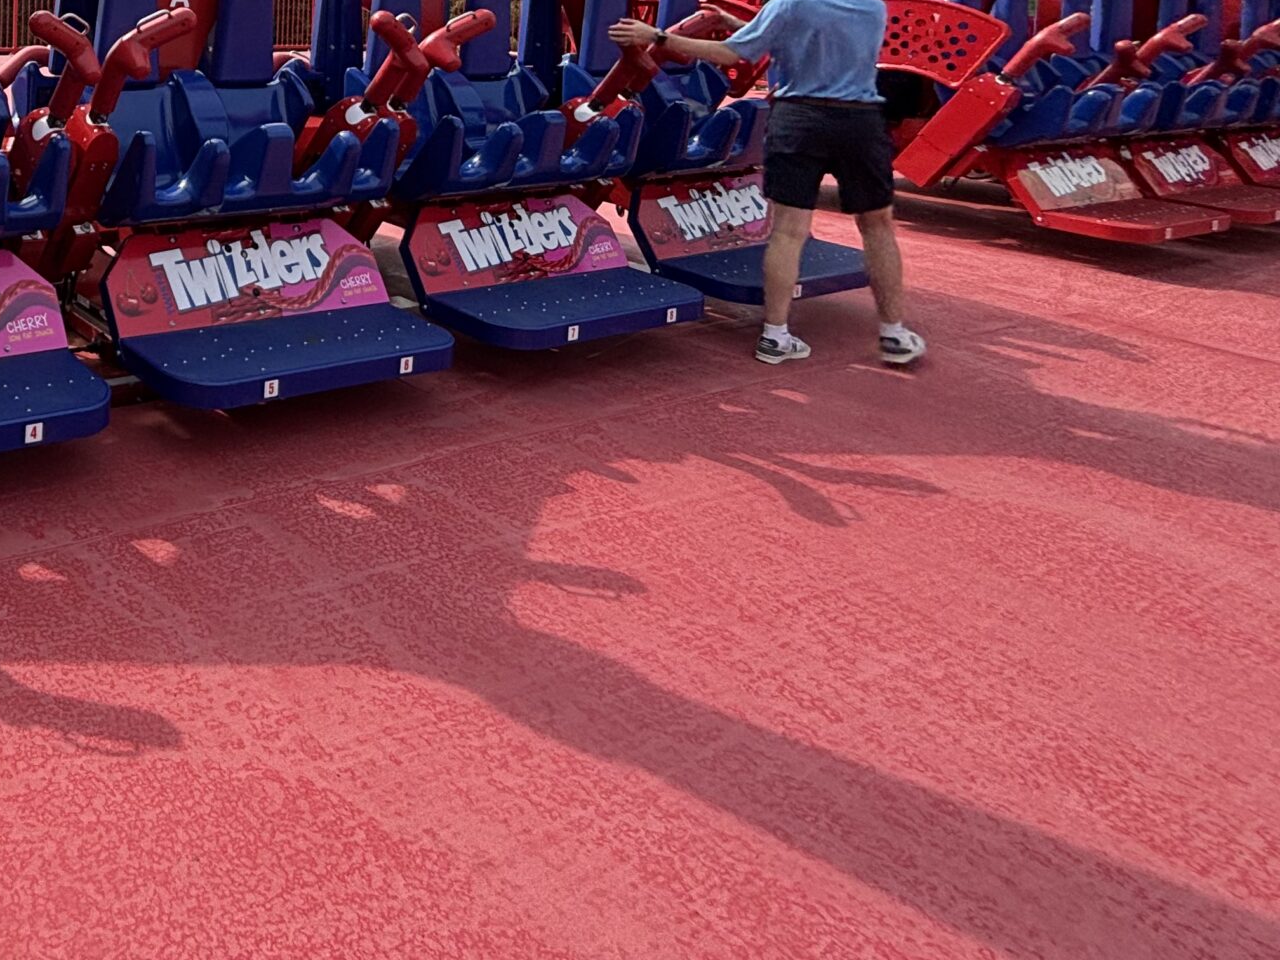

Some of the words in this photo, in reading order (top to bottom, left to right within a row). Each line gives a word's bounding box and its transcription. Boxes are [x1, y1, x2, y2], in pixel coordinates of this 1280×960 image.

[437, 203, 578, 272] Twizzlers
[148, 229, 330, 311] Twizzlers
[6, 312, 48, 333] CHERRY
[268, 382, 275, 395] 5
[30, 426, 37, 439] 4
